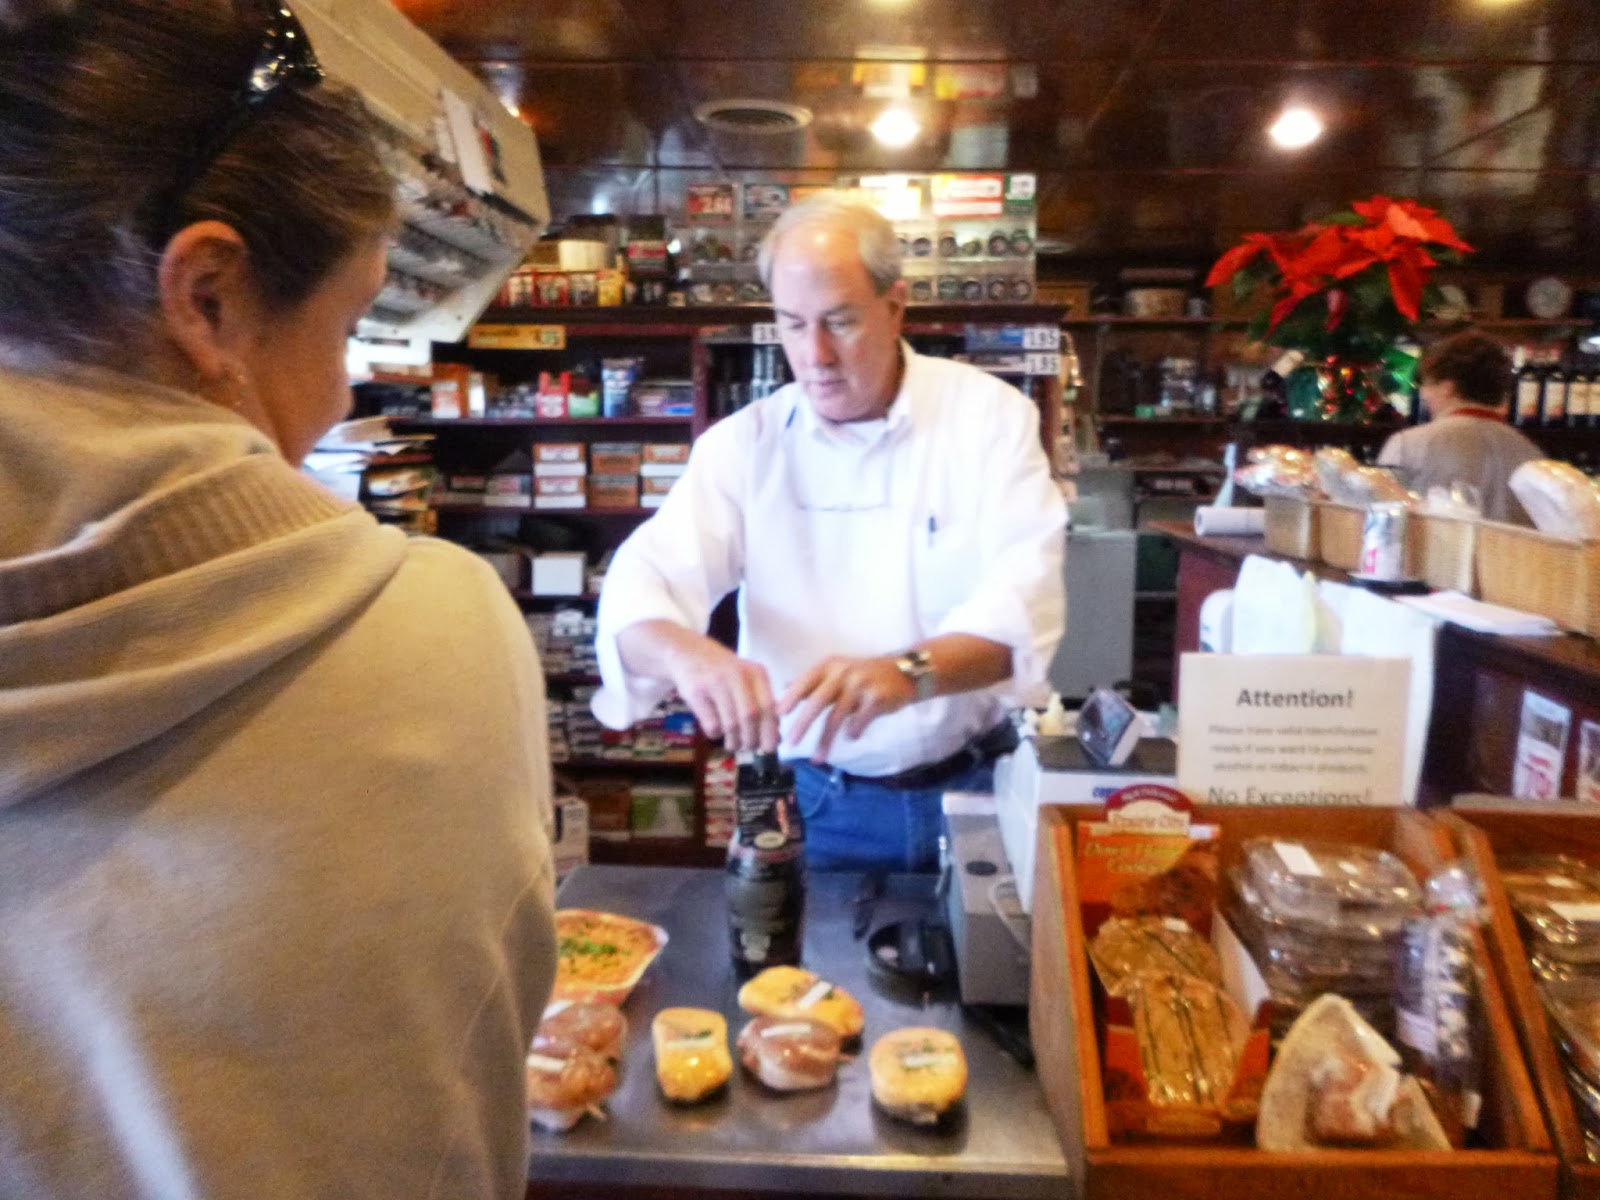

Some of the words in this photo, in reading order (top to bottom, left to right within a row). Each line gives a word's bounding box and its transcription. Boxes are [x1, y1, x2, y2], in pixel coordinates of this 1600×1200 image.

[1236, 688, 1354, 708] Attention!
[1207, 786, 1239, 805] No
[1246, 785, 1371, 805] Exceptions!
